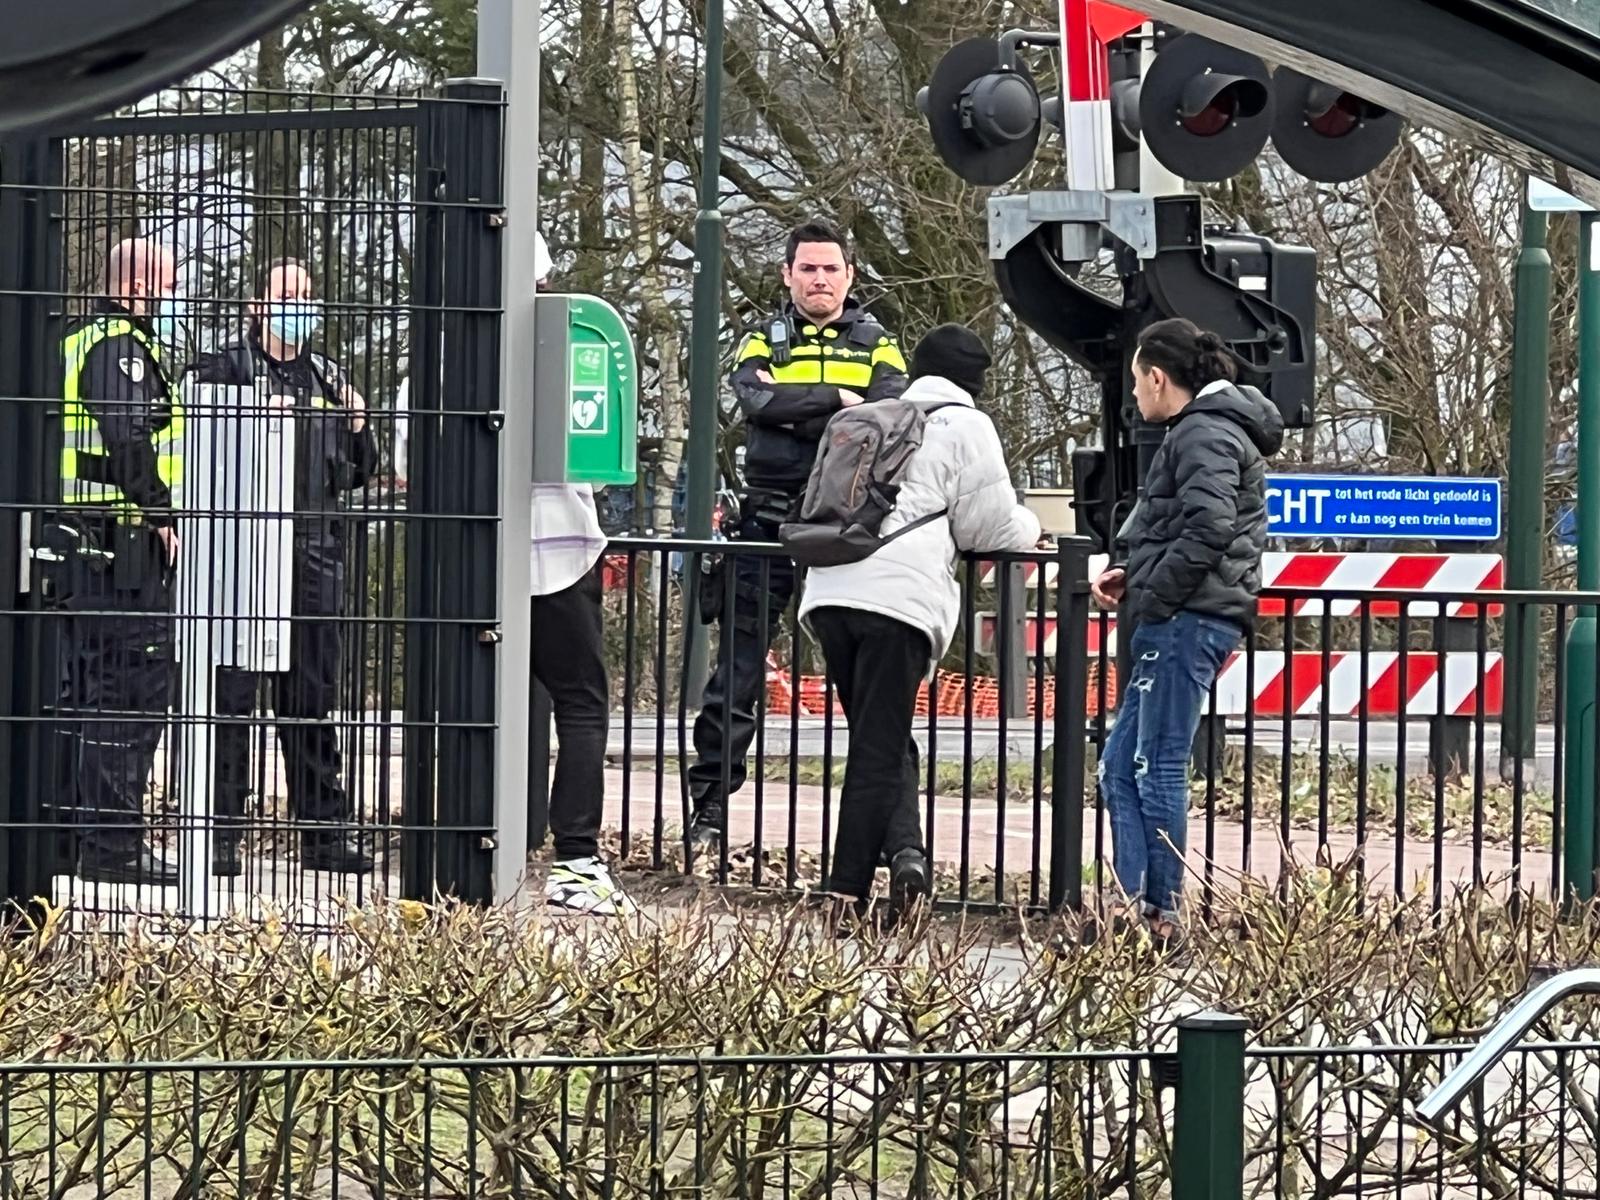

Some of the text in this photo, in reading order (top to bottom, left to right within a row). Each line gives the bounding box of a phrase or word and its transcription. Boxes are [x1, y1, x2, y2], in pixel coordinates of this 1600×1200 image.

[1335, 488, 1492, 504] tot het rode licht gedoofd is
[1335, 512, 1492, 528] er kan nog een trein komen
